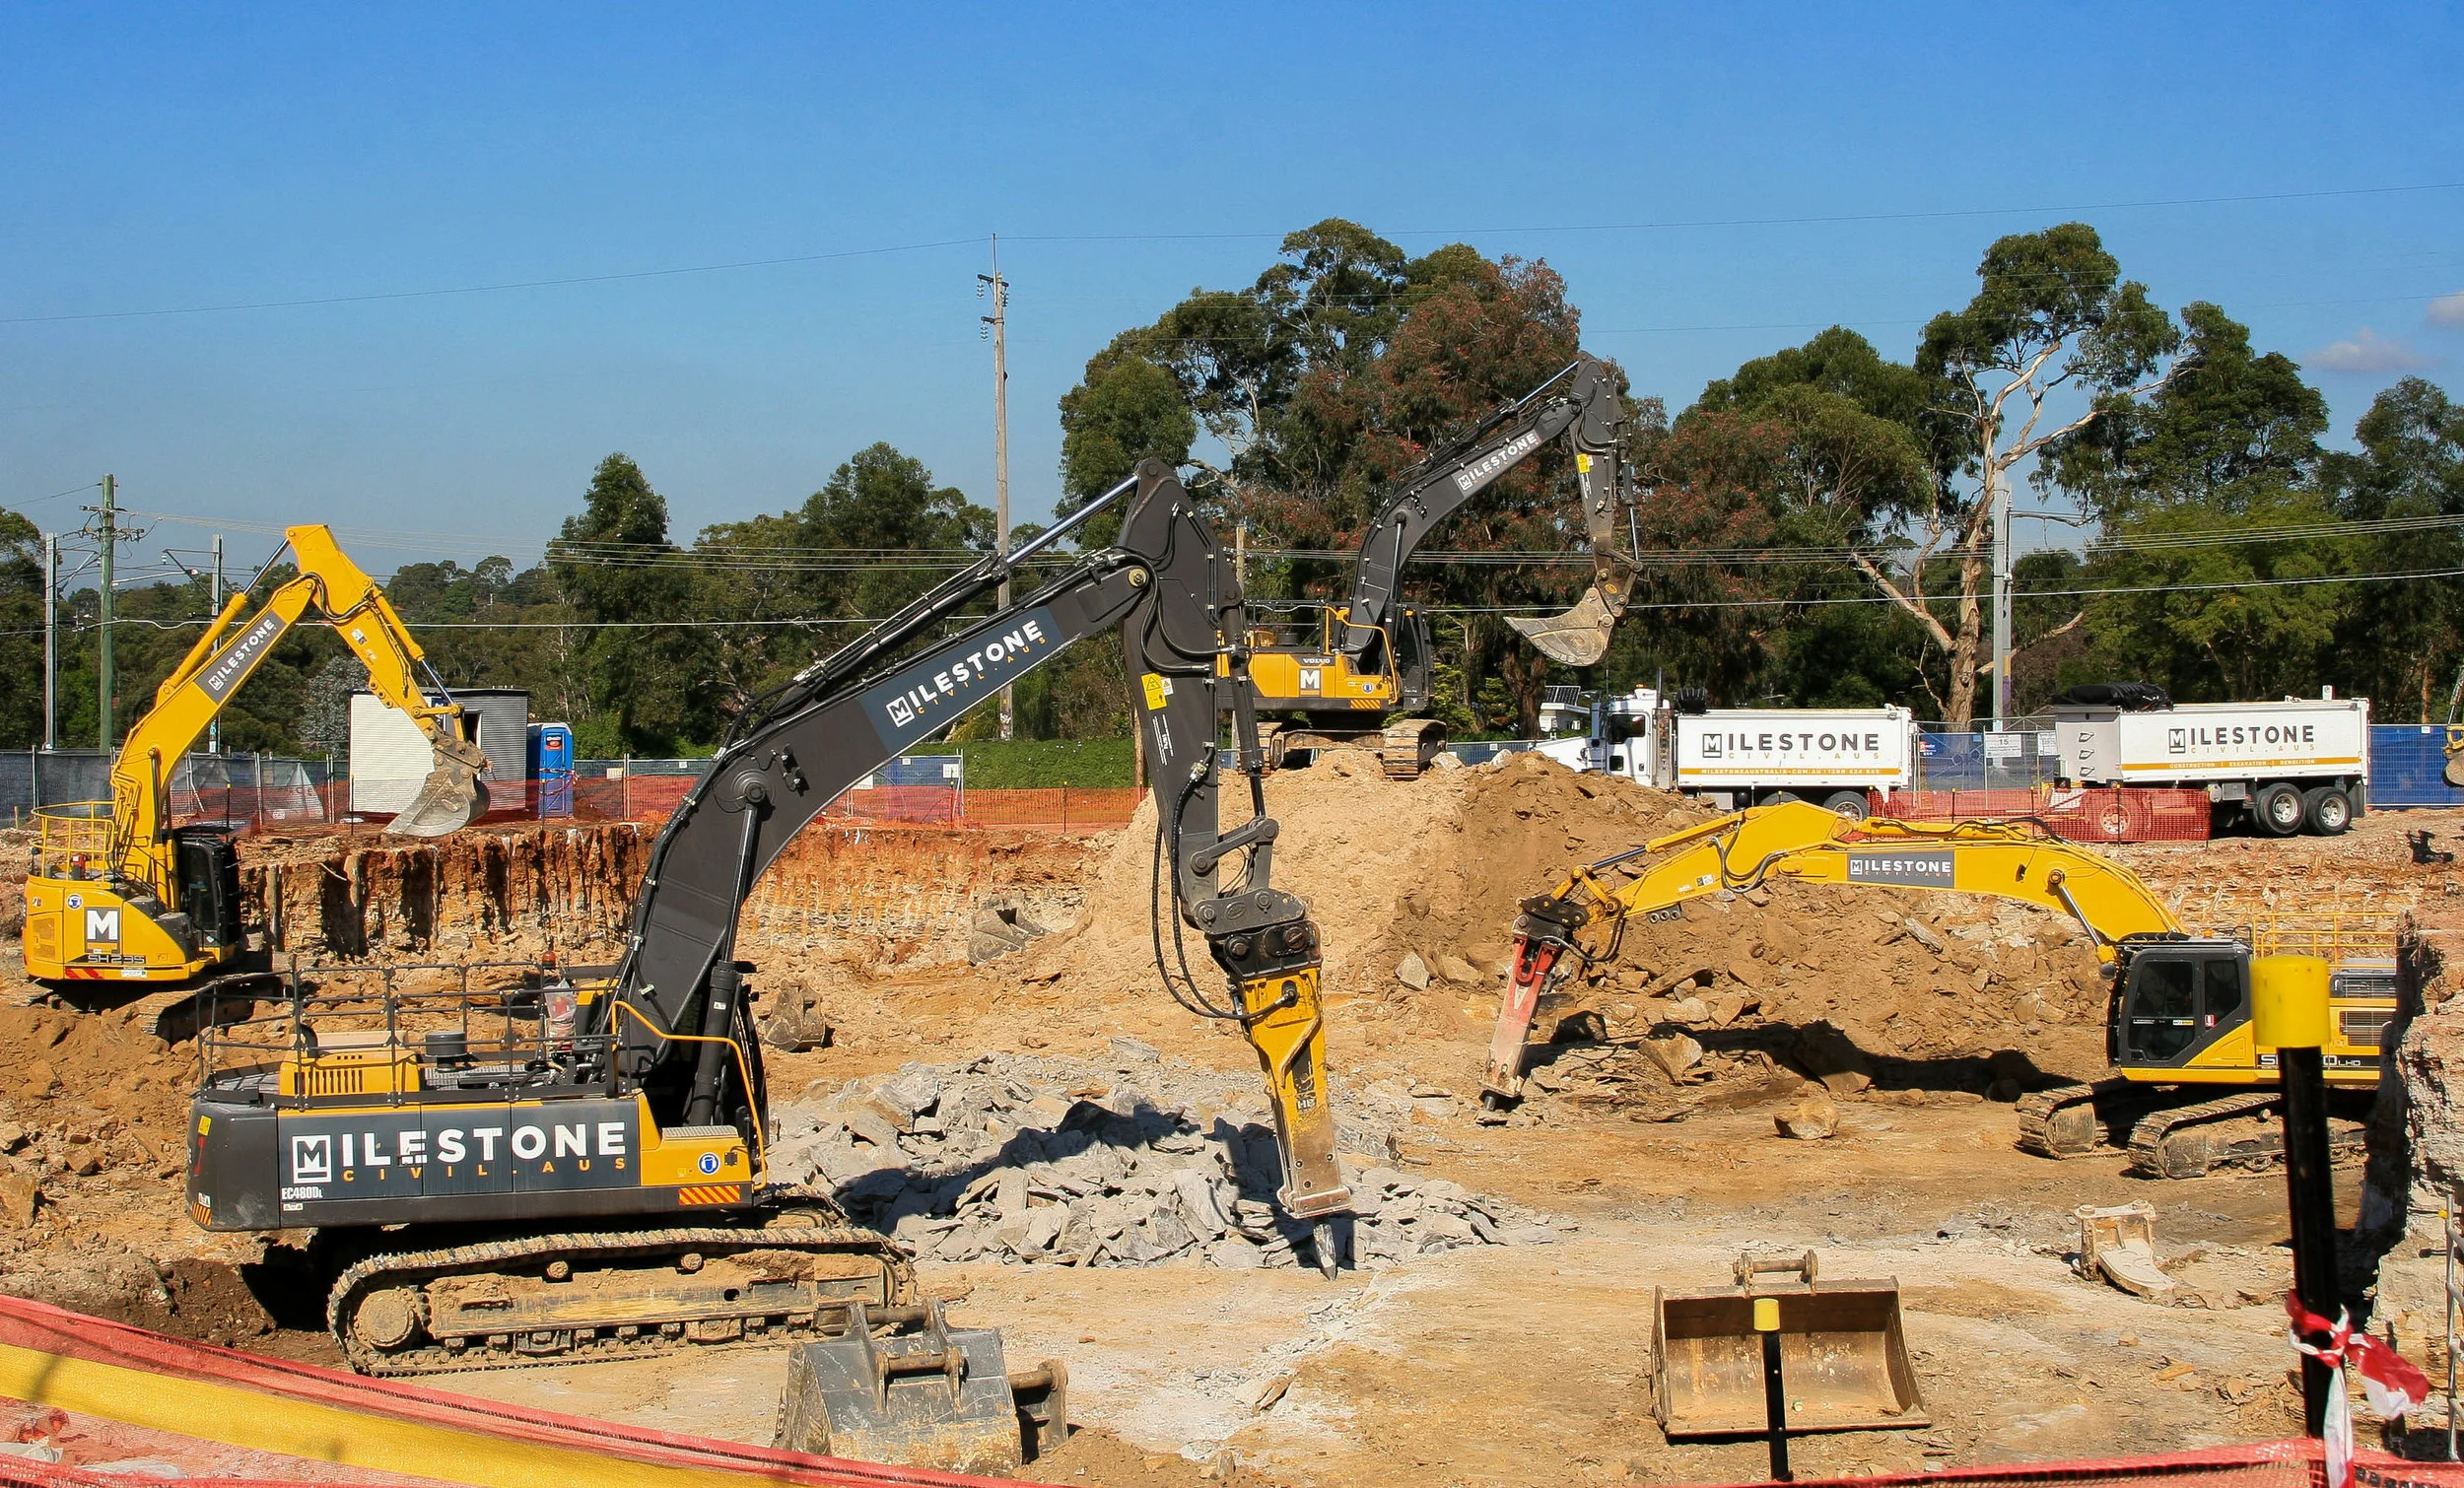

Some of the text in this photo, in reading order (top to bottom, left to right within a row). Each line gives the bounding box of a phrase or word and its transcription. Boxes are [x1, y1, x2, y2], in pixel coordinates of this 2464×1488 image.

[1458, 433, 1538, 491] MILESTONE
[208, 619, 275, 691] MILESTONE
[886, 620, 1043, 728] MILESTONE
[1300, 669, 1321, 689] M
[1702, 733, 1880, 759] MILESTONE
[2168, 725, 2314, 754] MILESTONE
[1850, 859, 1951, 875] MILESTONE
[87, 910, 119, 940] M
[292, 1121, 626, 1184] MILESTONE
